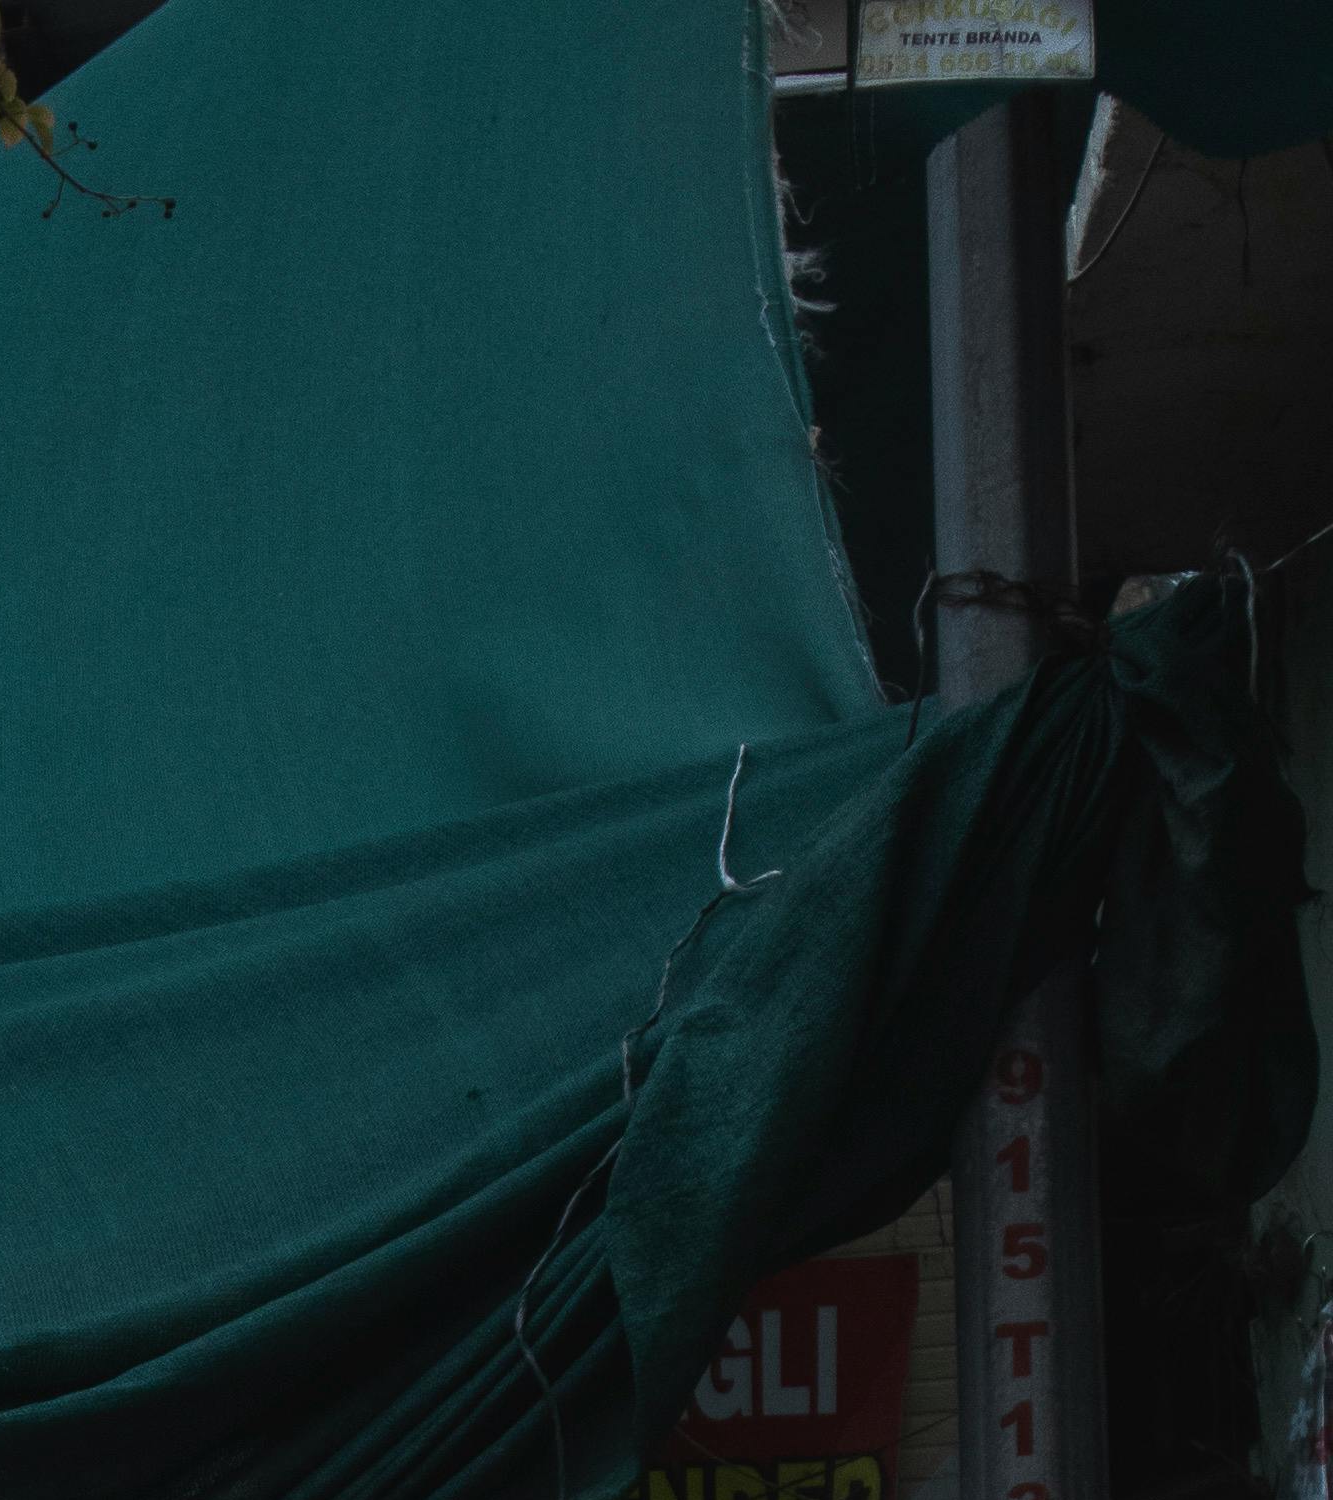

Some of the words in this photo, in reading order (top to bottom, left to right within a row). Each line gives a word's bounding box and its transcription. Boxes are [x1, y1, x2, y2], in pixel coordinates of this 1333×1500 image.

[900, 31, 961, 47] TENTE
[965, 29, 1042, 45] BRANDA
[681, 1304, 839, 1421] GLI
